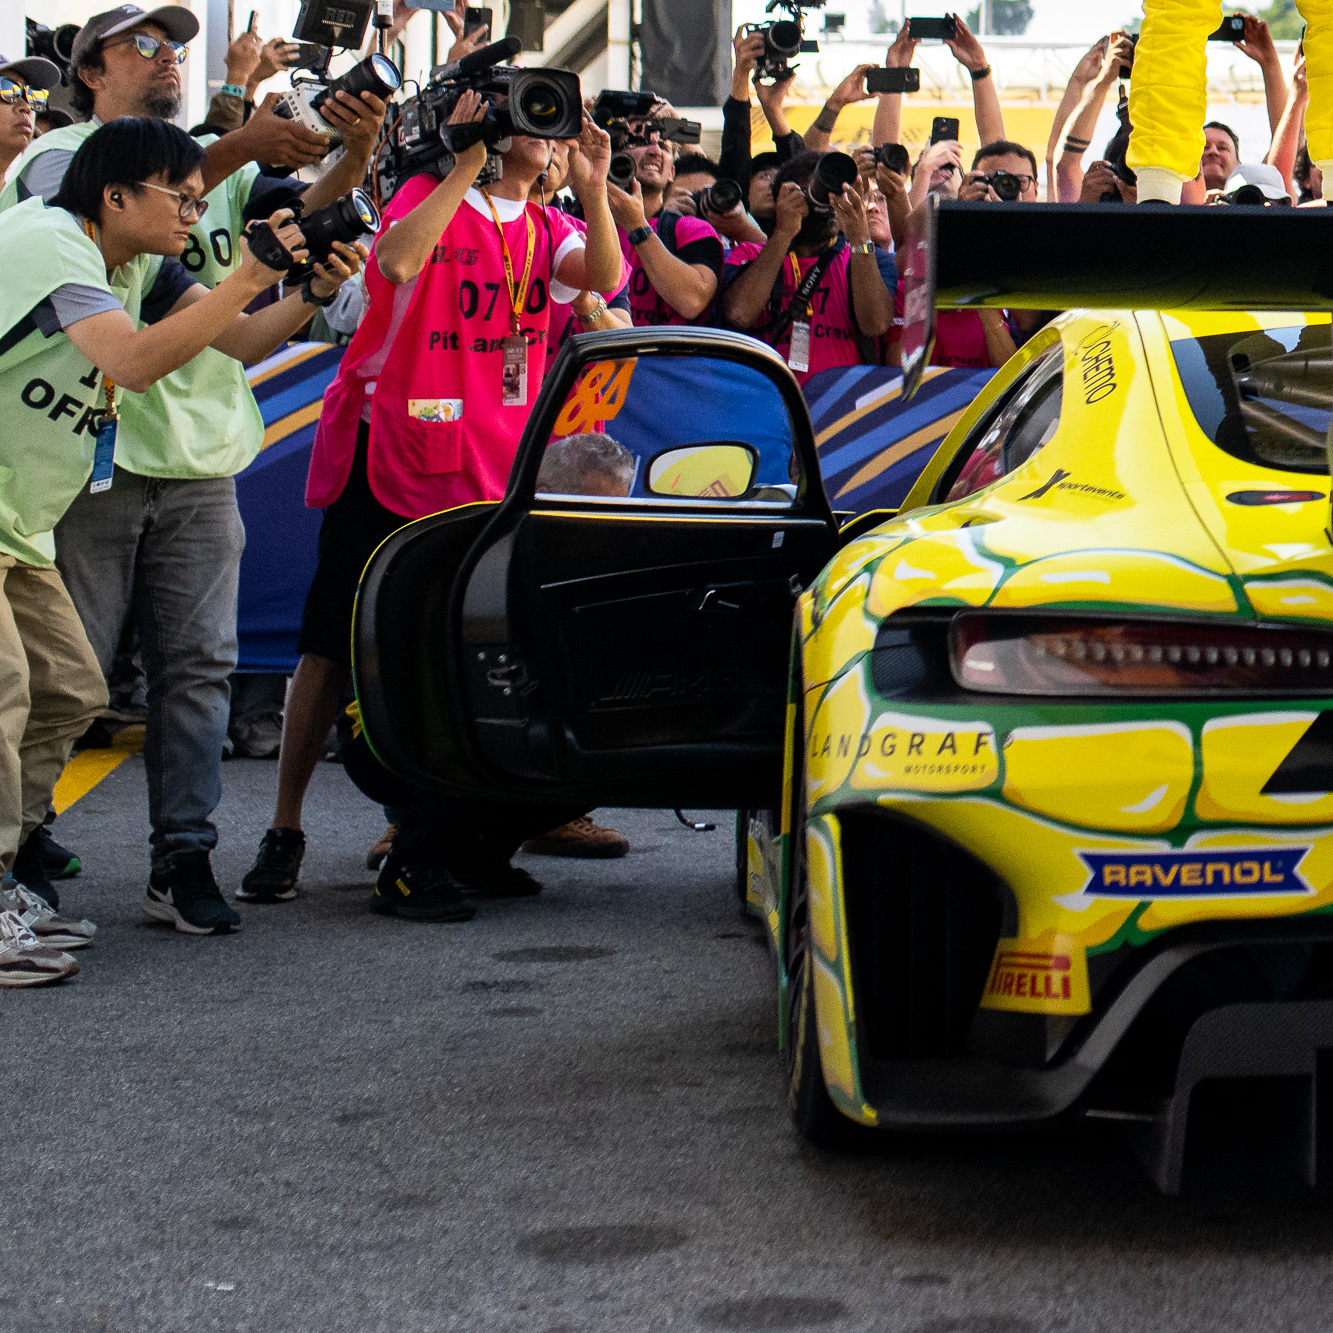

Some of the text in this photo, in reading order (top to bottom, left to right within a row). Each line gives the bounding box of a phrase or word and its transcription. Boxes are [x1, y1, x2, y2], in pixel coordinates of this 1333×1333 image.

[801, 265, 821, 296] SONY
[429, 330, 459, 351] Pit
[1081, 340, 1118, 405] CHEMO
[810, 731, 995, 759] LANDGRAF
[903, 763, 988, 776] MOTORSPORT
[1102, 862, 1285, 888] RAVENOL
[990, 953, 1072, 1002] PIRELLI
